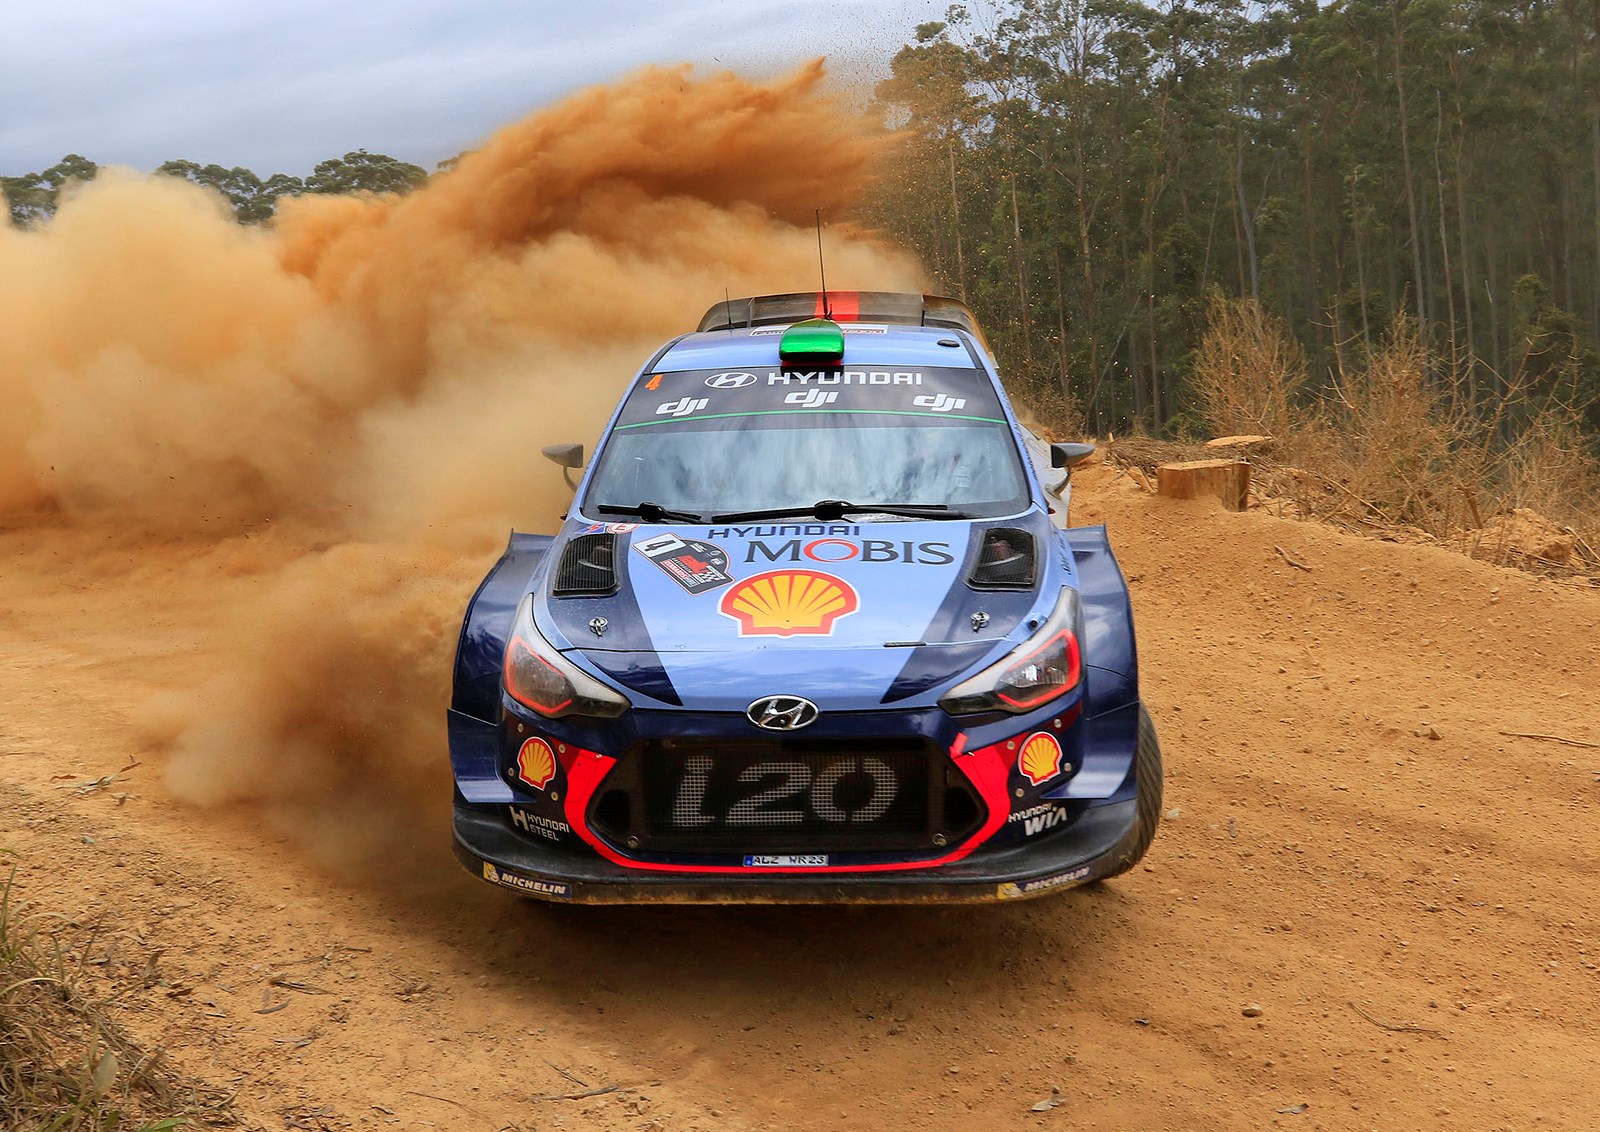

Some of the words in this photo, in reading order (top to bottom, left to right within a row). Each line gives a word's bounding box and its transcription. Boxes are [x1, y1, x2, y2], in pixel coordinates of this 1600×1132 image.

[645, 374, 663, 391] 4
[767, 371, 922, 386] HYUNDAI
[707, 525, 860, 539] HYUNDAI
[644, 539, 677, 552] 4
[743, 538, 955, 566] MOBIS
[1008, 802, 1058, 823] HYUNDAI
[1024, 807, 1068, 836] WIA
[526, 812, 570, 834] HYUNDAI
[529, 823, 560, 842] STEEL
[754, 856, 780, 865] ALZ
[501, 872, 567, 895] MICHELIN
[1024, 866, 1090, 892] MICHELIN
